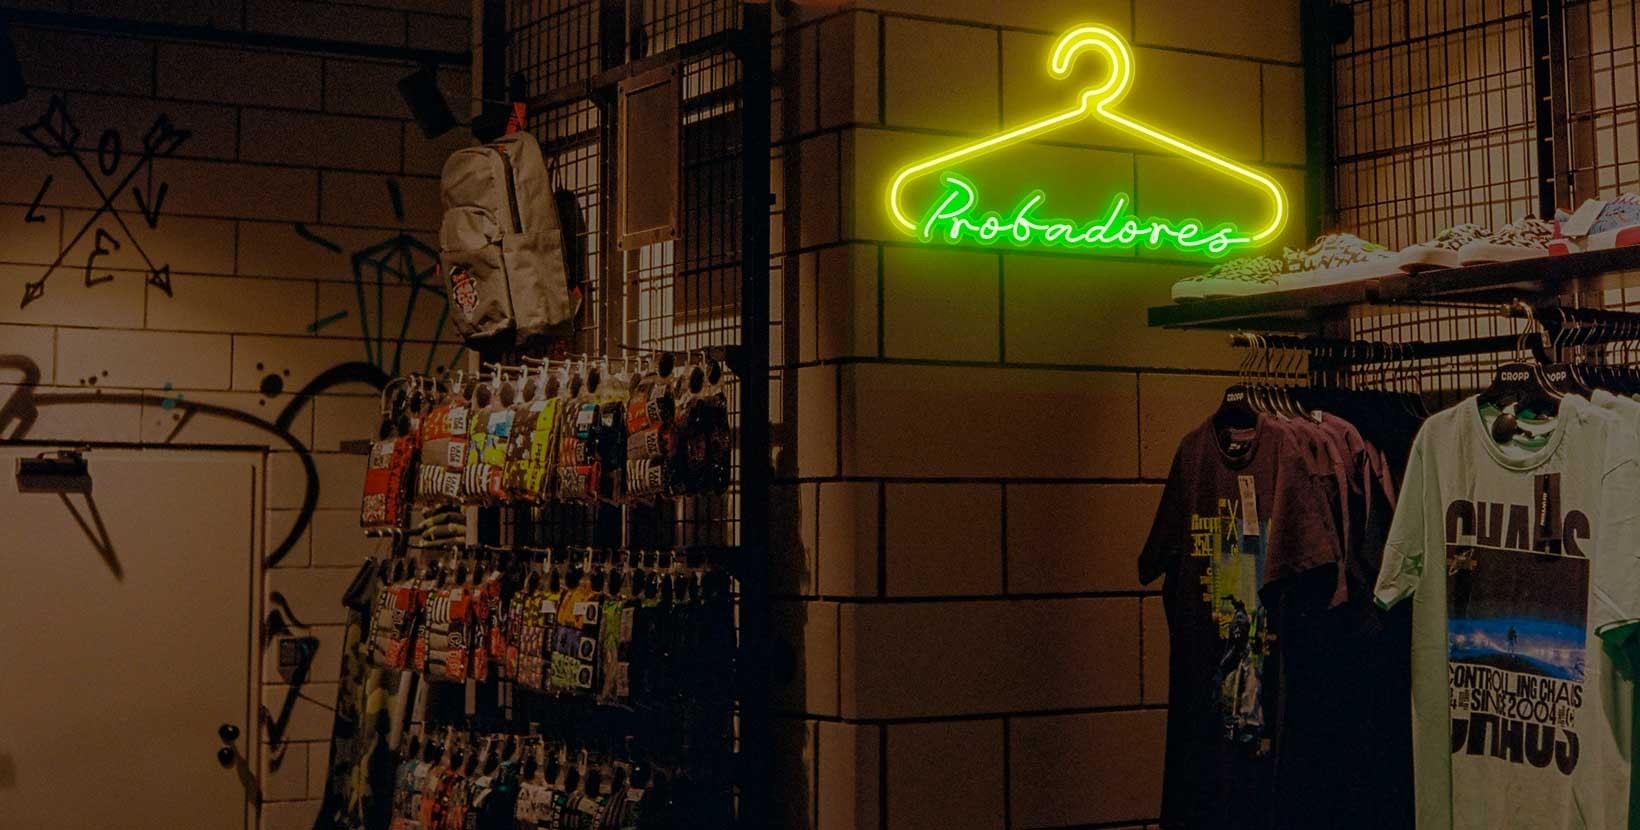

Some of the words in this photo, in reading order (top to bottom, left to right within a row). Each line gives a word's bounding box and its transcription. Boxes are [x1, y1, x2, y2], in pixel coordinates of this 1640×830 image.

[922, 175, 1252, 254] Probadores
[1500, 371, 1530, 382] CROPP
[1508, 697, 1557, 726] 2004
